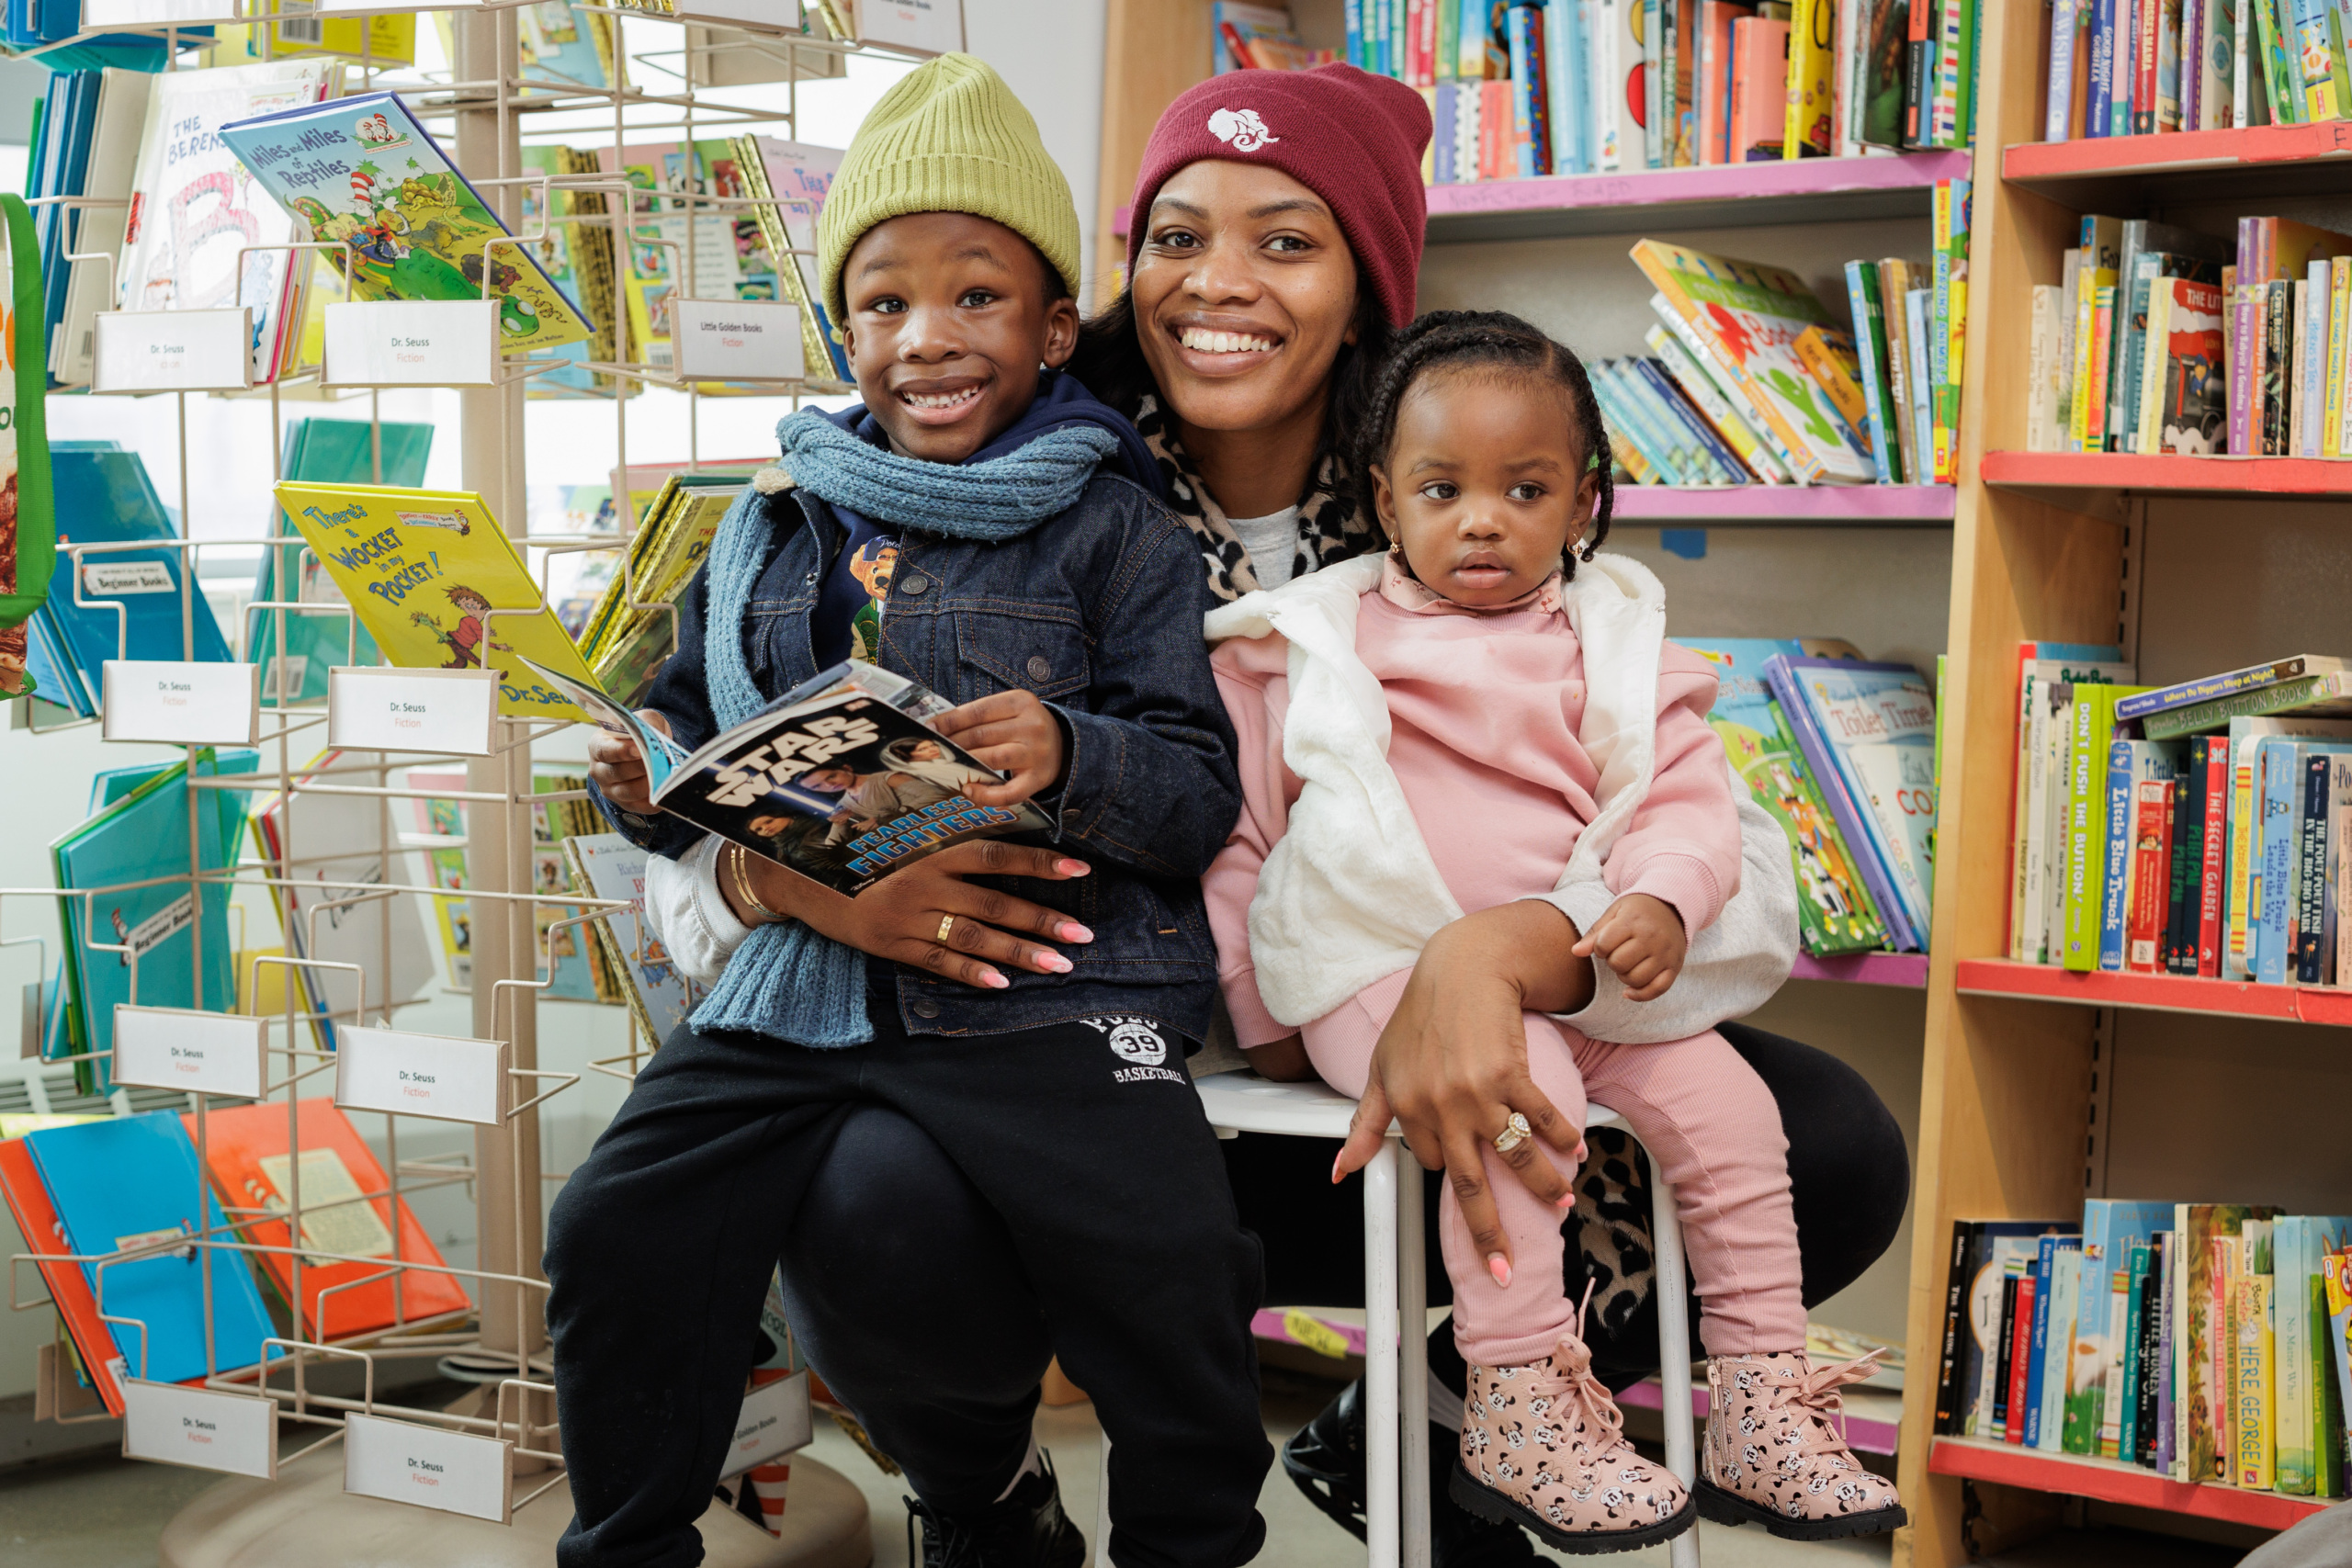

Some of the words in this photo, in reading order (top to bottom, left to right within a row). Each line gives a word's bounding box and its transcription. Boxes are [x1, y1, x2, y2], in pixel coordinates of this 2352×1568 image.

[2100, 25, 2114, 57] GOOD
[2142, 35, 2154, 71] MAMA
[2090, 34, 2102, 83] GORILLA
[173, 115, 201, 139] THE
[248, 143, 289, 170] Miles
[288, 144, 306, 155] and
[297, 128, 348, 152] Miles
[277, 158, 351, 190] Reptiles
[291, 157, 302, 171] of
[1936, 253, 1948, 317] AMAZING
[2187, 287, 2204, 308] THE
[2239, 305, 2249, 322] How
[2272, 289, 2283, 318] OWL
[701, 321, 717, 332] Little
[718, 321, 741, 333] Golden
[743, 322, 763, 333] Books
[2239, 324, 2248, 334] to
[150, 344, 161, 355] Dr.
[163, 344, 185, 355] Seuss
[390, 337, 403, 347] Dr.
[405, 337, 430, 348] Seuss
[722, 337, 744, 348] Fiction
[1936, 321, 1948, 385] ANIMALS
[2236, 336, 2248, 367] Babysit
[2256, 336, 2267, 366] Babysit
[396, 353, 424, 364] Fiction
[2327, 382, 2338, 412] THUMB
[301, 502, 368, 530] There's
[345, 527, 359, 538] a
[328, 527, 403, 573] WOCKET
[375, 561, 390, 574] in
[388, 555, 406, 568] my
[368, 551, 444, 606] POCKET!
[159, 681, 169, 691] Dr.
[171, 682, 191, 692] Seuss
[498, 683, 534, 703] Dr.
[2164, 689, 2187, 705] Where
[2188, 687, 2197, 698] Do
[2198, 683, 2223, 697] Diggers
[2223, 678, 2242, 690] Sleep
[2243, 675, 2251, 685] at
[2252, 668, 2276, 684] Night?
[163, 696, 187, 706] Fiction
[390, 702, 401, 713] Dr.
[402, 703, 426, 714] Seuss
[2177, 707, 2213, 730] BELLY
[2218, 694, 2267, 719] BUTTON
[2270, 682, 2308, 705] BOOK!
[394, 716, 421, 728] Fiction
[1830, 705, 1888, 738] Toilet
[1881, 700, 1933, 728] Time
[2076, 702, 2092, 749] DON'T
[705, 716, 879, 808] WARS
[715, 715, 854, 784] STAR
[2075, 754, 2090, 795] PUSH
[2073, 801, 2088, 828] THE
[2110, 787, 2127, 836] Little
[2208, 791, 2223, 814] THE
[846, 795, 976, 854] FEARLESS
[2305, 818, 2315, 832] IN
[2314, 818, 2325, 842] THE
[844, 806, 1018, 877] FIGHTERS
[2187, 825, 2203, 859] PETER
[2206, 819, 2222, 867] SECRET
[2278, 839, 2288, 868] Little
[2304, 834, 2315, 856] THE
[2071, 832, 2086, 904] BUTTON!
[2109, 839, 2125, 875] Blue
[2171, 845, 2187, 877] PETER
[2267, 844, 2277, 876] Leads
[850, 876, 876, 893] Disney
[2186, 860, 2202, 887] PAN
[2277, 871, 2287, 897] Blue
[2301, 857, 2314, 901] BIG-BIG
[2312, 843, 2324, 907] POUT-POUT
[2170, 879, 2185, 903] PAN
[2203, 872, 2219, 921] GARDEN
[2234, 879, 2245, 899] BUS
[2266, 879, 2275, 897] the
[2106, 876, 2122, 931] Truck
[2263, 900, 2274, 925] Way
[2274, 899, 2285, 932] Truck
[2300, 903, 2312, 934] DARK
[2311, 908, 2323, 935] FISH
[171, 1047, 182, 1056] Dr.
[183, 1048, 204, 1059] Seuss
[1118, 1034, 1159, 1055] 39
[175, 1062, 200, 1074] Fiction
[399, 1070, 411, 1081] Dr.
[413, 1071, 435, 1084] Seuss
[1112, 1066, 1187, 1086] BASKETBALL
[402, 1086, 430, 1099] Fiction
[2177, 1231, 2185, 1263] Autumn
[2041, 1261, 2050, 1278] Hill
[2134, 1273, 2143, 1289] Hill
[2038, 1293, 2048, 1325] Where's
[2150, 1297, 2162, 1343] LITTLE
[2286, 1315, 2296, 1332] No
[2286, 1334, 2297, 1370] Matter
[2148, 1347, 2160, 1396] WOMEN
[2238, 1346, 2260, 1395] HERE,
[2312, 1359, 2322, 1383] Look
[2286, 1371, 2297, 1401] What
[2312, 1384, 2323, 1408] After
[2177, 1398, 2187, 1421] Gerda
[2313, 1410, 2323, 1424] Us
[183, 1416, 194, 1427] Dr.
[195, 1418, 217, 1431] Seuss
[736, 1424, 759, 1440] Golden
[759, 1415, 777, 1430] Books
[2240, 1395, 2261, 1469] GEORGE!
[187, 1432, 212, 1445] Fiction
[739, 1438, 760, 1451] Fiction
[408, 1457, 420, 1469] Dr.
[421, 1460, 444, 1473] Seuss
[412, 1472, 439, 1487] Fiction
